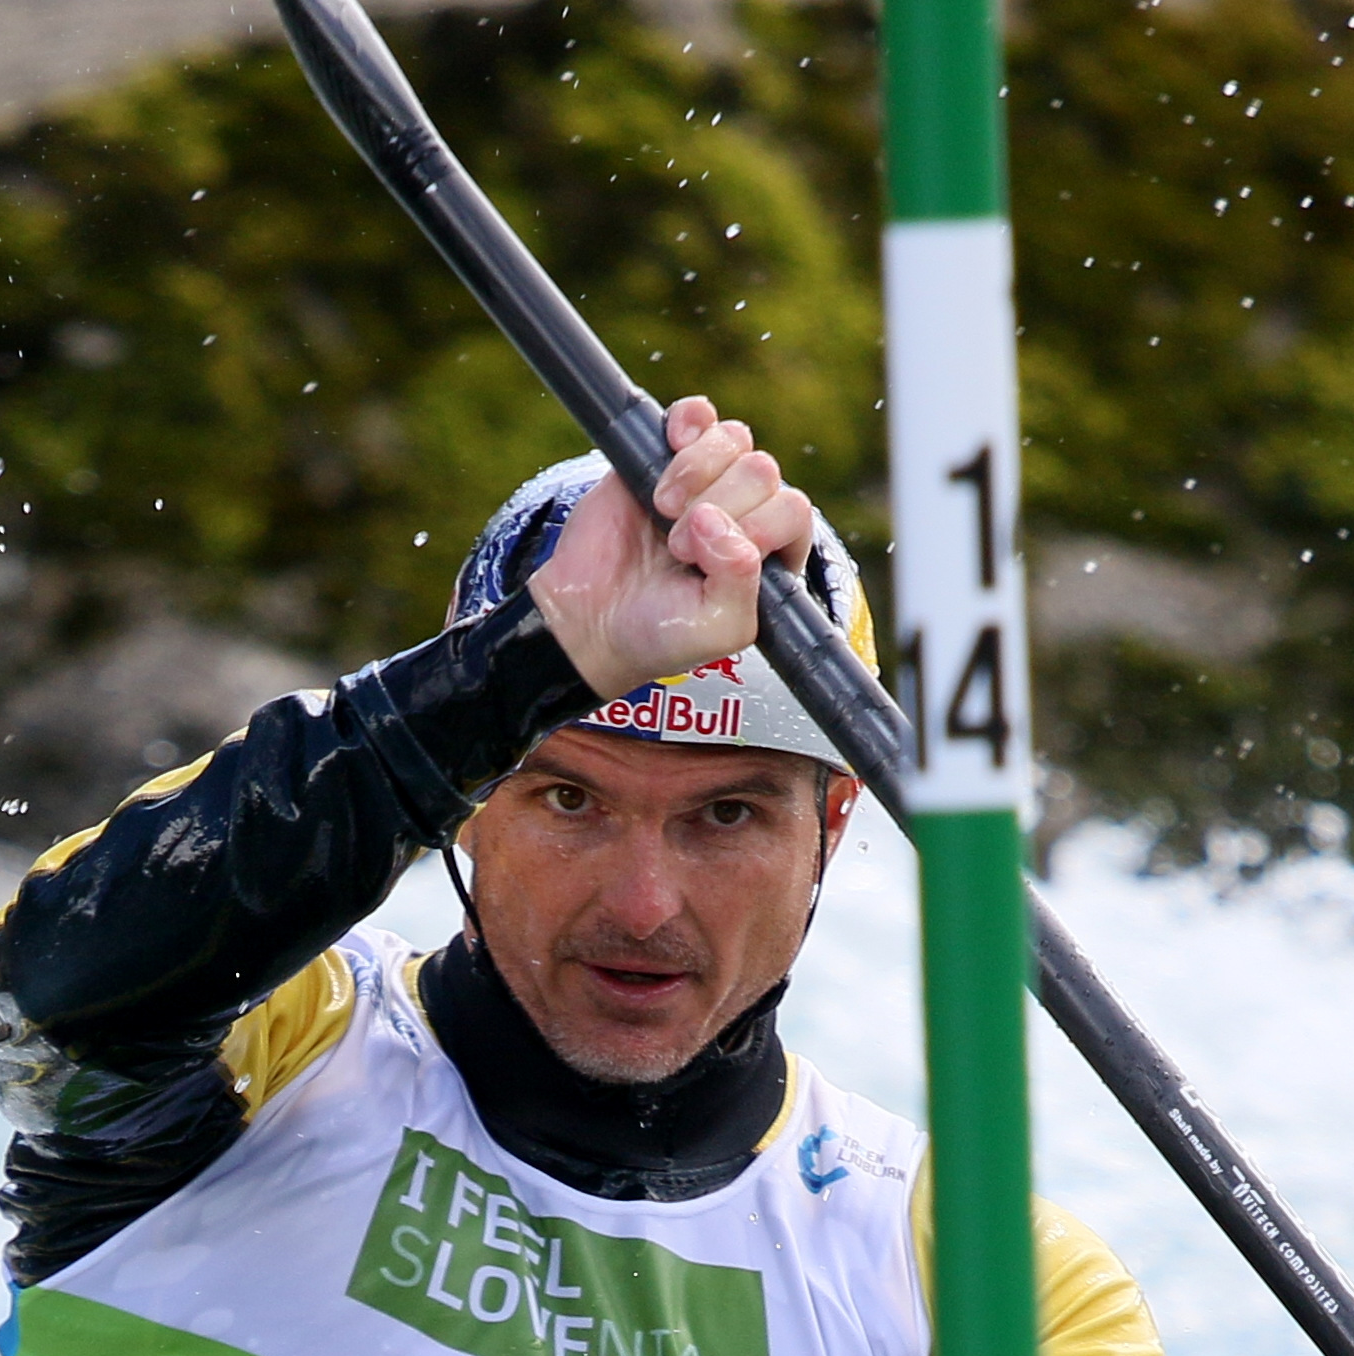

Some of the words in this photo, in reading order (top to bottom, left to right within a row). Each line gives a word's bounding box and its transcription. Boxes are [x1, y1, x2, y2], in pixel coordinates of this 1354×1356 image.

[665, 694, 742, 737] Bull
[898, 622, 1009, 772] 14
[1168, 1108, 1193, 1136] Shaft
[1188, 1133, 1213, 1162] made
[1210, 1158, 1224, 1176] by
[399, 1150, 435, 1213] I
[447, 1171, 581, 1299] FEEL
